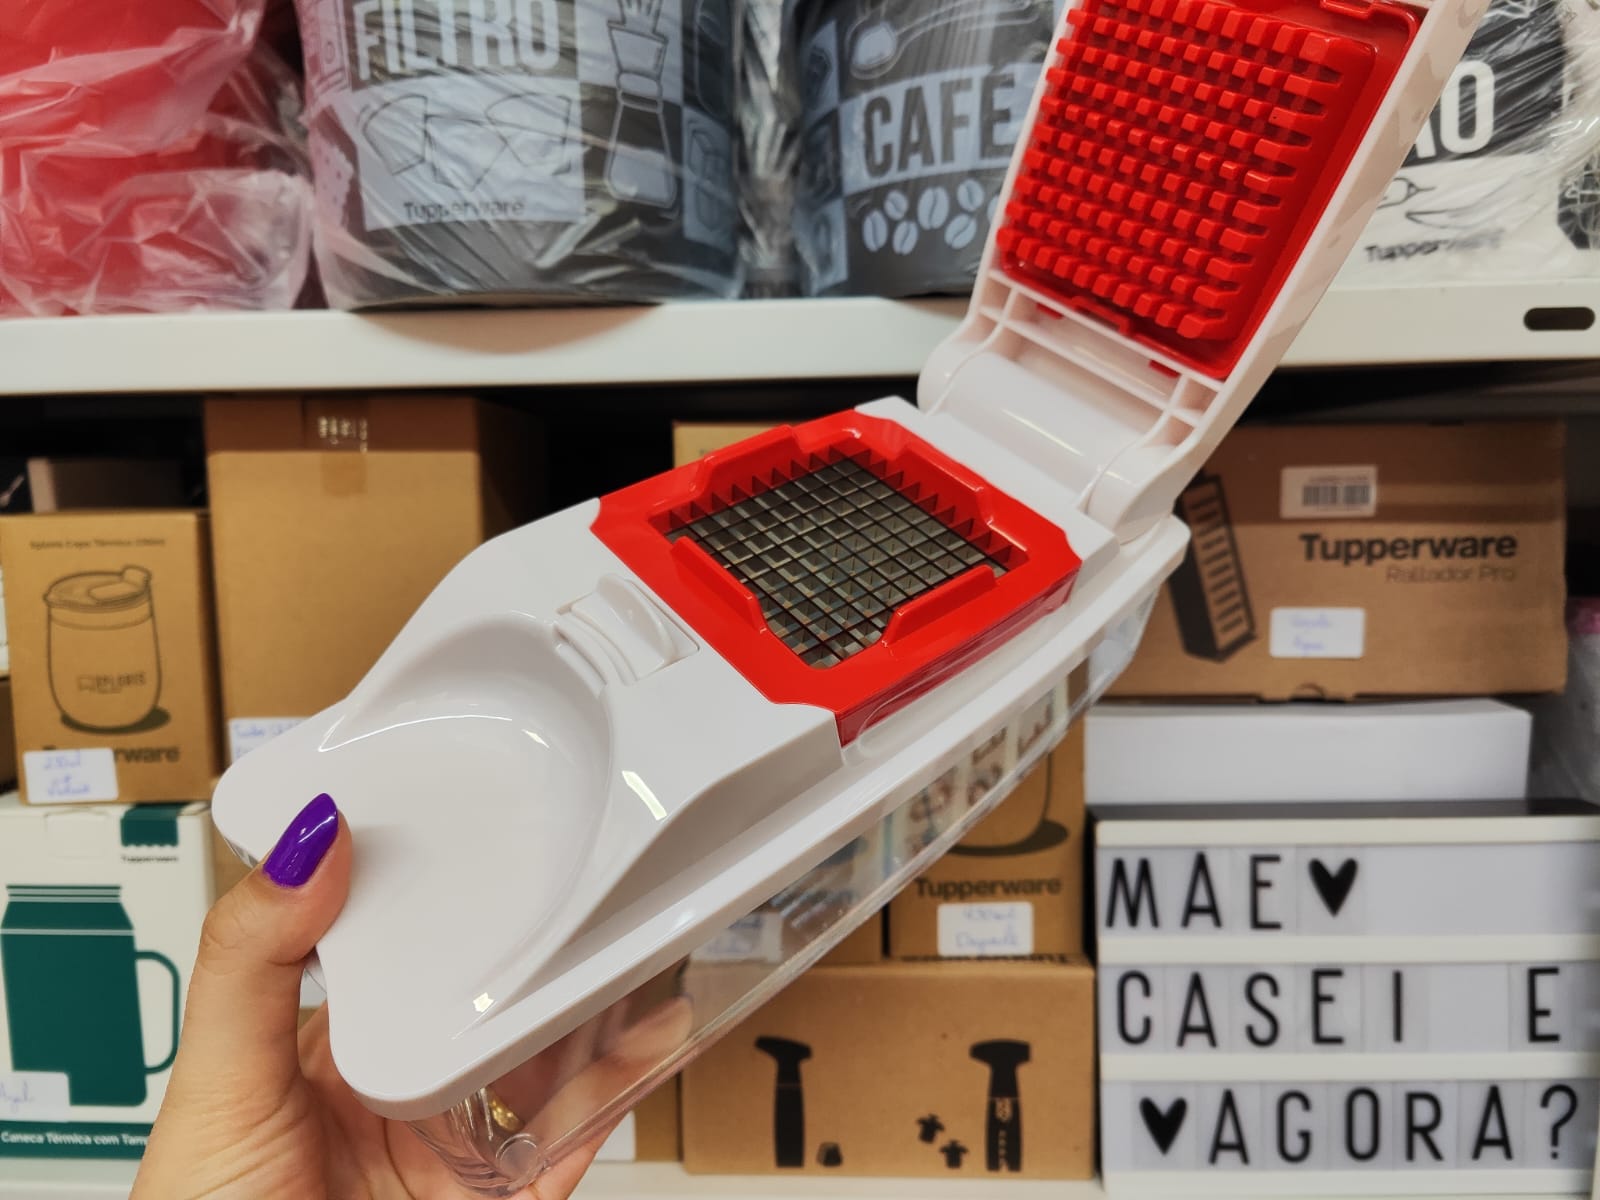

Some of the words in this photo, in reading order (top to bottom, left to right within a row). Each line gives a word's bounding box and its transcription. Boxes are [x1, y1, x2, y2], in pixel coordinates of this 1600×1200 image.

[1299, 533, 1517, 567] Tupperware
[914, 876, 1062, 901] Tupperware
[1105, 851, 1282, 930] MAE
[1116, 969, 1403, 1048] CASEI
[1527, 966, 1561, 1044] E
[1, 1131, 44, 1145] Caneca
[93, 1134, 120, 1146] com
[1208, 1084, 1579, 1166] AGORA?
